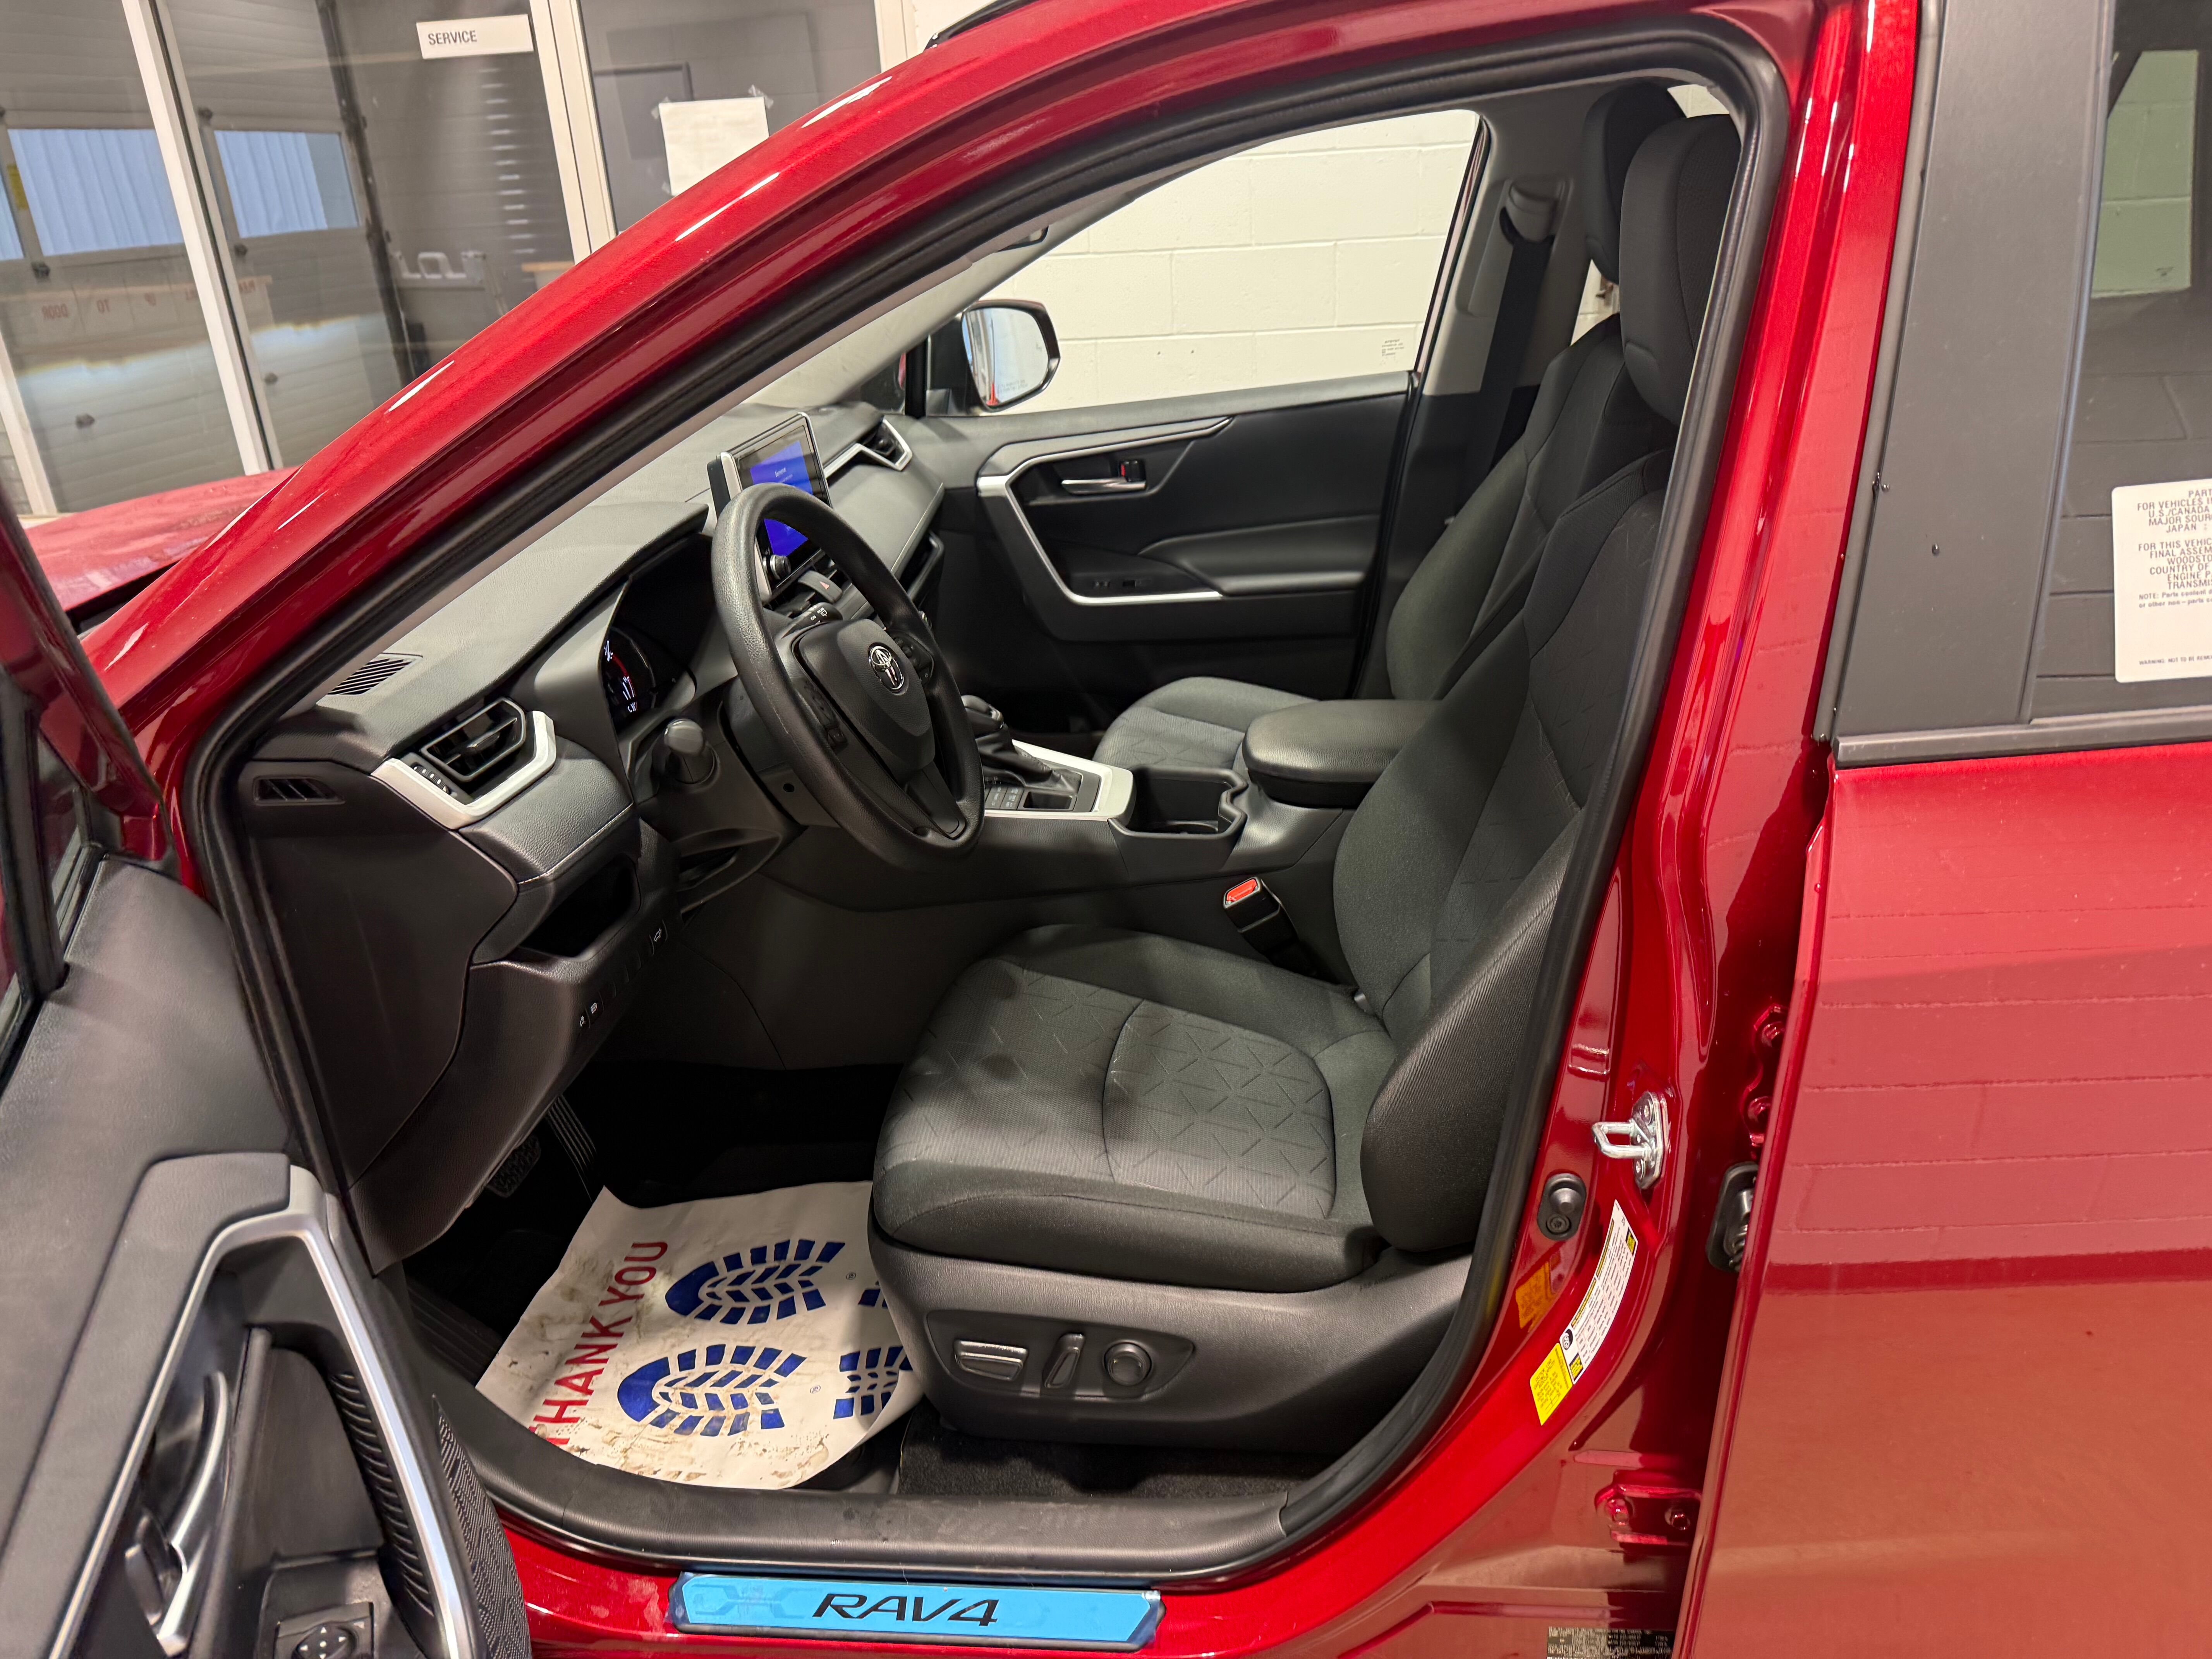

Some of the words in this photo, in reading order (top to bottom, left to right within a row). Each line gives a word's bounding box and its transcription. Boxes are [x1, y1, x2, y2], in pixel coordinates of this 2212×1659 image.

[428, 30, 477, 45] SERVICE
[2137, 502, 2155, 511] FOR
[2159, 497, 2203, 509] VEHICLES
[2149, 516, 2182, 526] MAJOR
[2185, 514, 2212, 523] SOUR
[2166, 523, 2197, 533] JAPAN
[2138, 543, 2156, 551] FOR
[2160, 540, 2181, 549] THIS
[2150, 549, 2176, 559] FINAL
[2150, 564, 2194, 575] COUNTRY
[2198, 563, 2209, 571] OF
[2167, 571, 2201, 581] ENGINE
[2168, 579, 2212, 590] TRANSMI
[598, 1241, 668, 1307] YOU
[812, 1593, 999, 1627] RAV4
